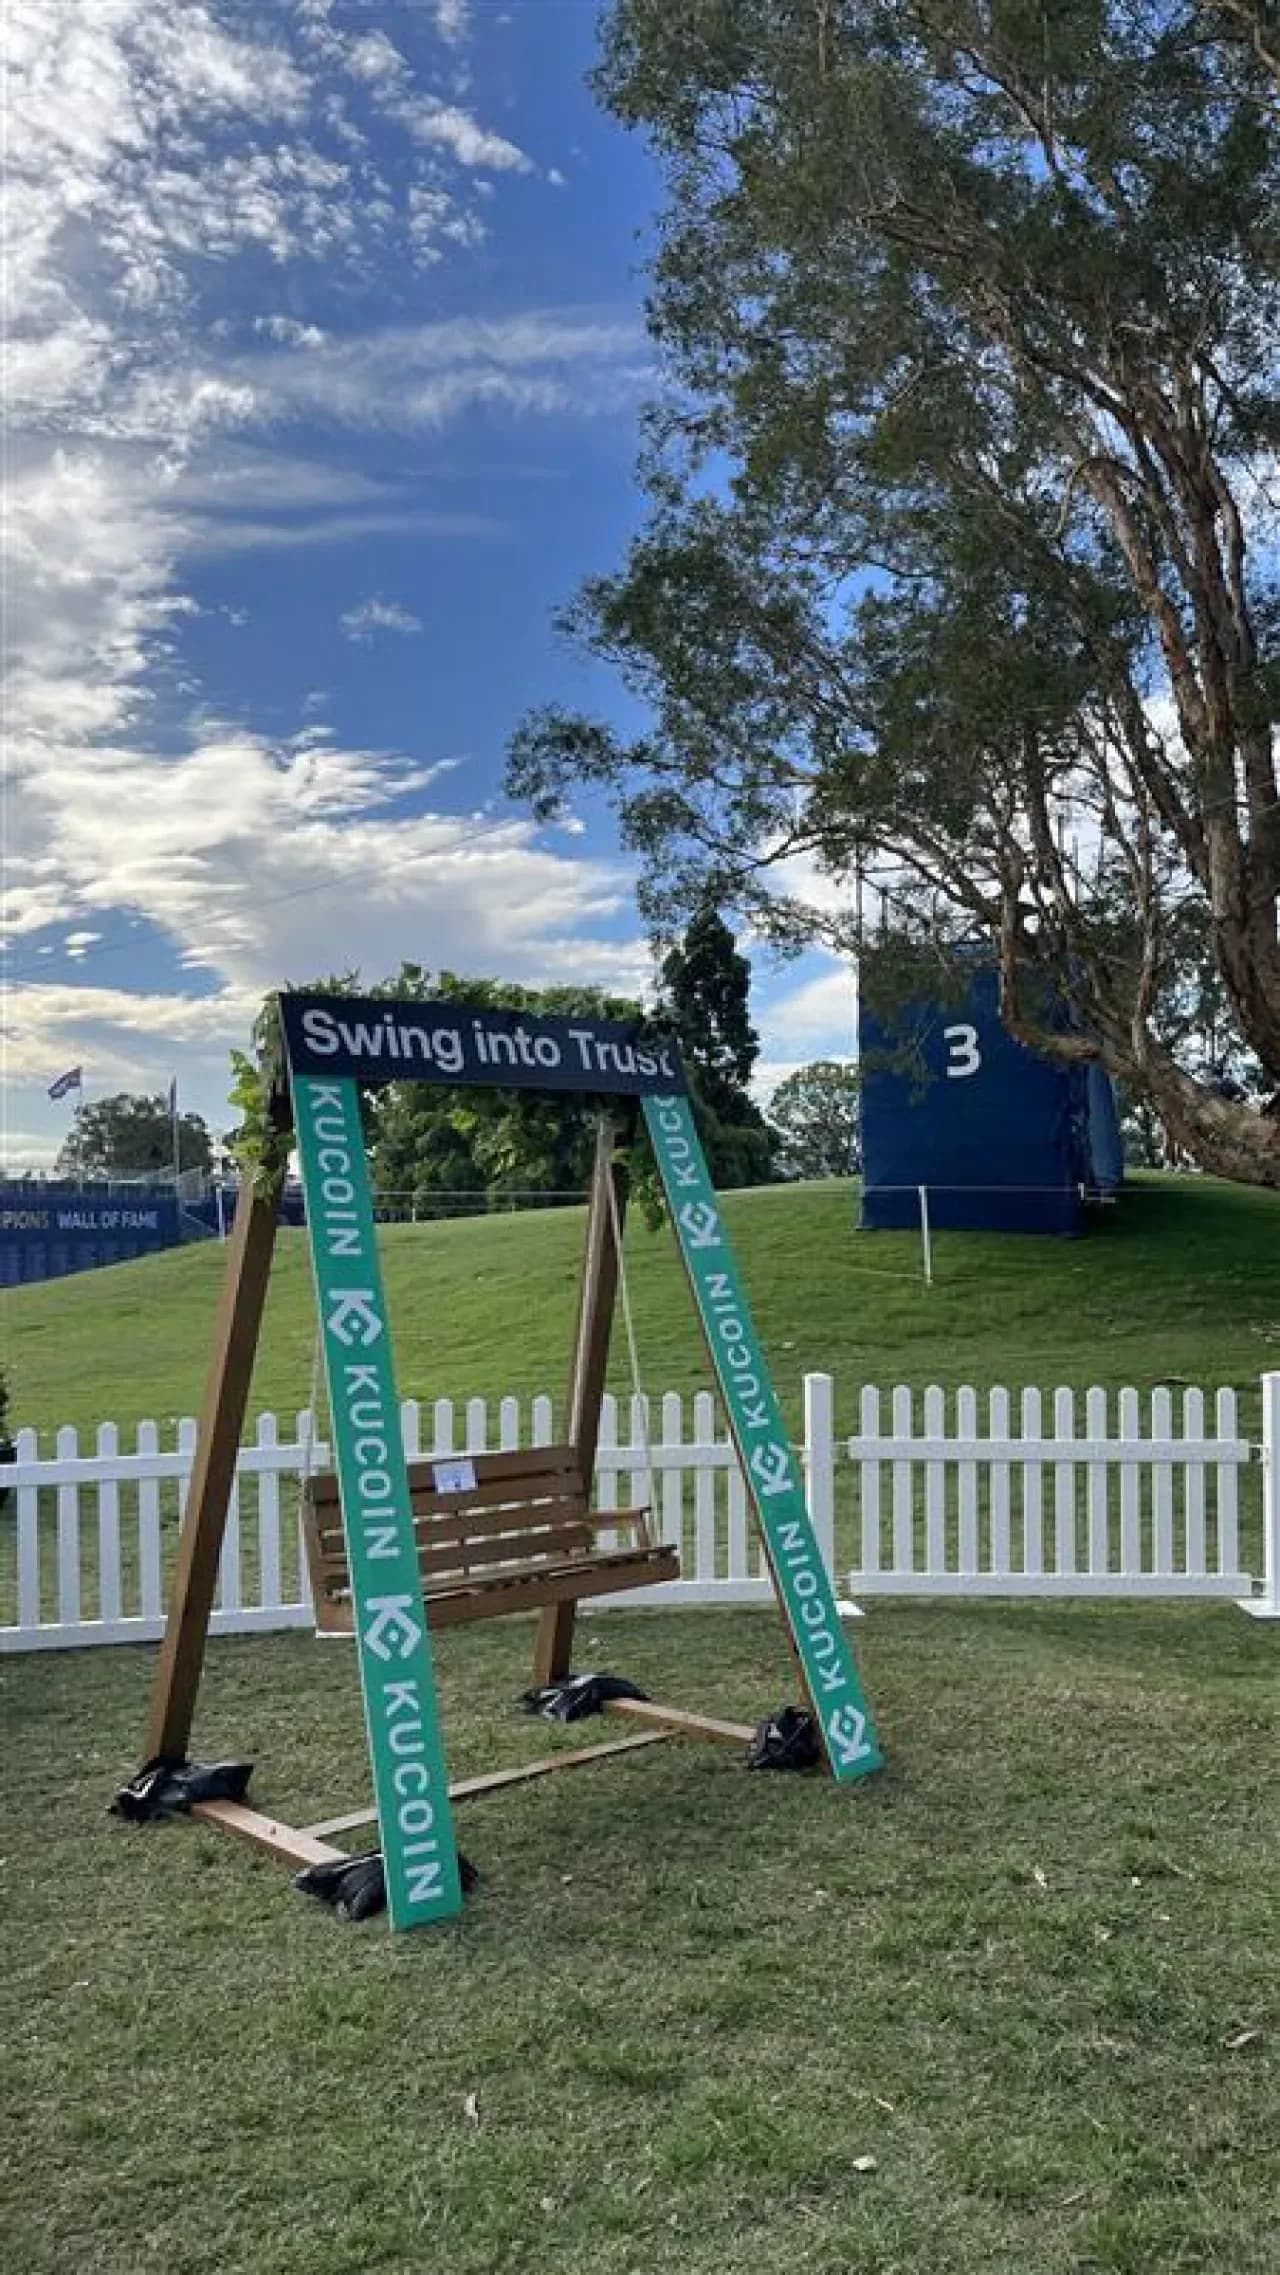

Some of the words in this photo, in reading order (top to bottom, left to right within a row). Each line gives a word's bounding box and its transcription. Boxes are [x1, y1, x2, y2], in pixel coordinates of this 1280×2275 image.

[303, 1009, 464, 1073] Swing
[472, 1019, 562, 1069] into
[568, 1028, 675, 1078] Trust
[944, 1024, 981, 1078] 3
[57, 1210, 98, 1230] WALL
[101, 1210, 120, 1230] OF
[122, 1210, 159, 1230] FAME
[309, 1082, 363, 1256] KUCOIN
[705, 1273, 770, 1429] KUCOIN
[344, 1365, 401, 1560] KUCOIN
[776, 1521, 846, 1692] KUCOIN
[383, 1680, 443, 1903] KUCOIN
